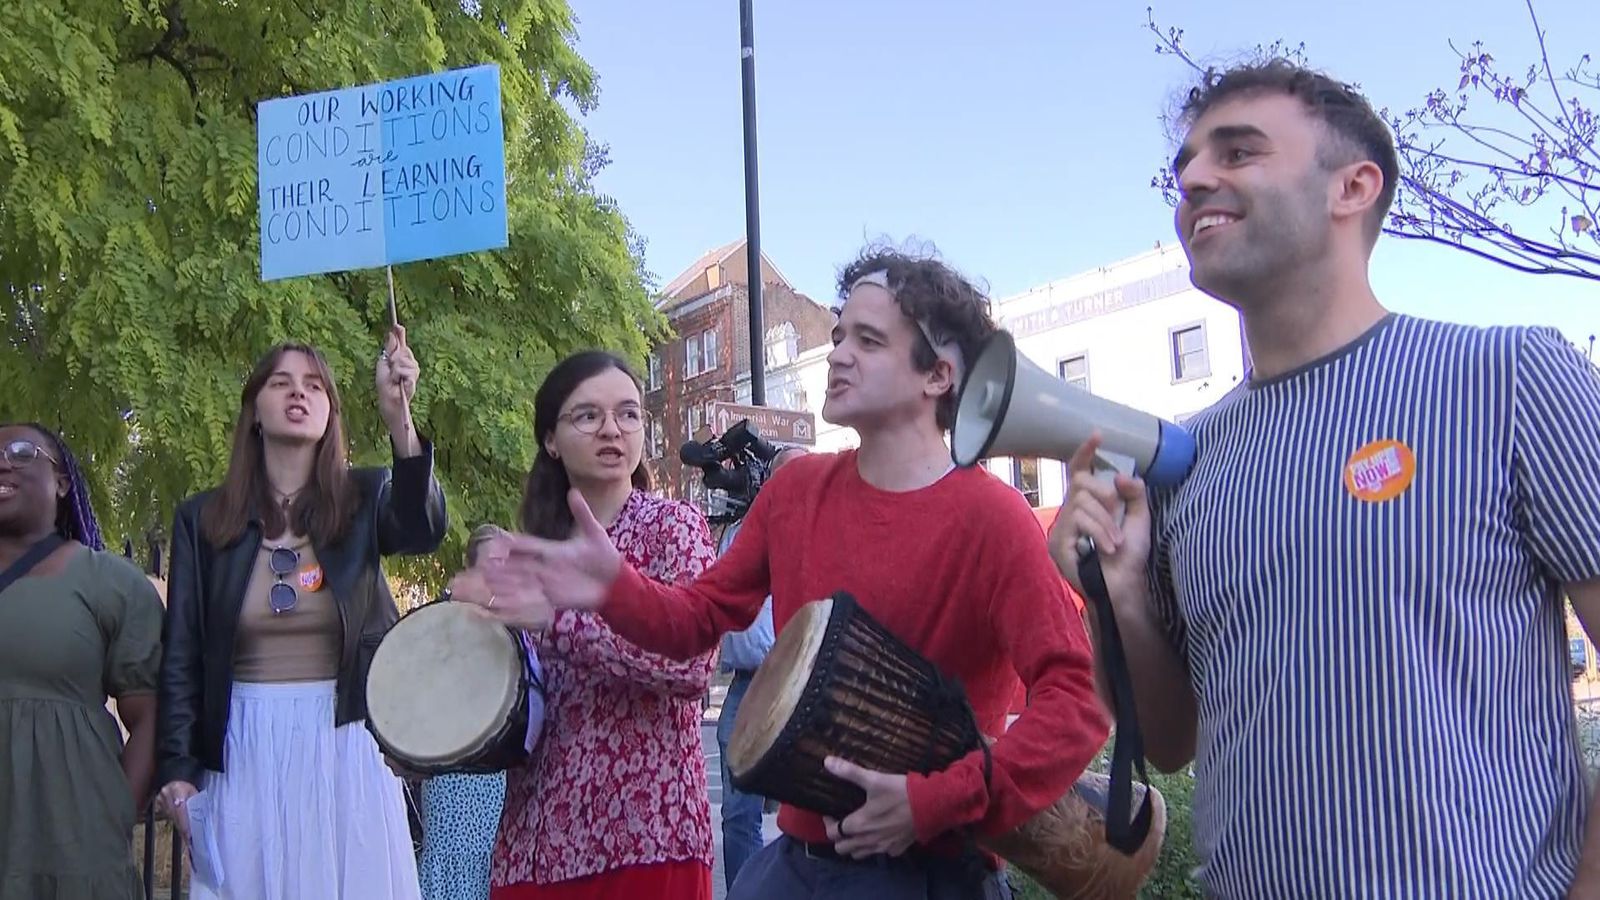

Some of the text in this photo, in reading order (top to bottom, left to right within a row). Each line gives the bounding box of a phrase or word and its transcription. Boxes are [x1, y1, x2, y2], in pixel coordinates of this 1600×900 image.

[297, 75, 475, 127] OUR WORKING
[266, 101, 491, 167] CONDITIONS
[351, 149, 399, 169] are
[267, 154, 484, 210] THEIR LEARNING
[267, 180, 495, 245] CONDITIONS
[1064, 289, 1124, 322] TURNER
[730, 410, 790, 426] Imperial War
